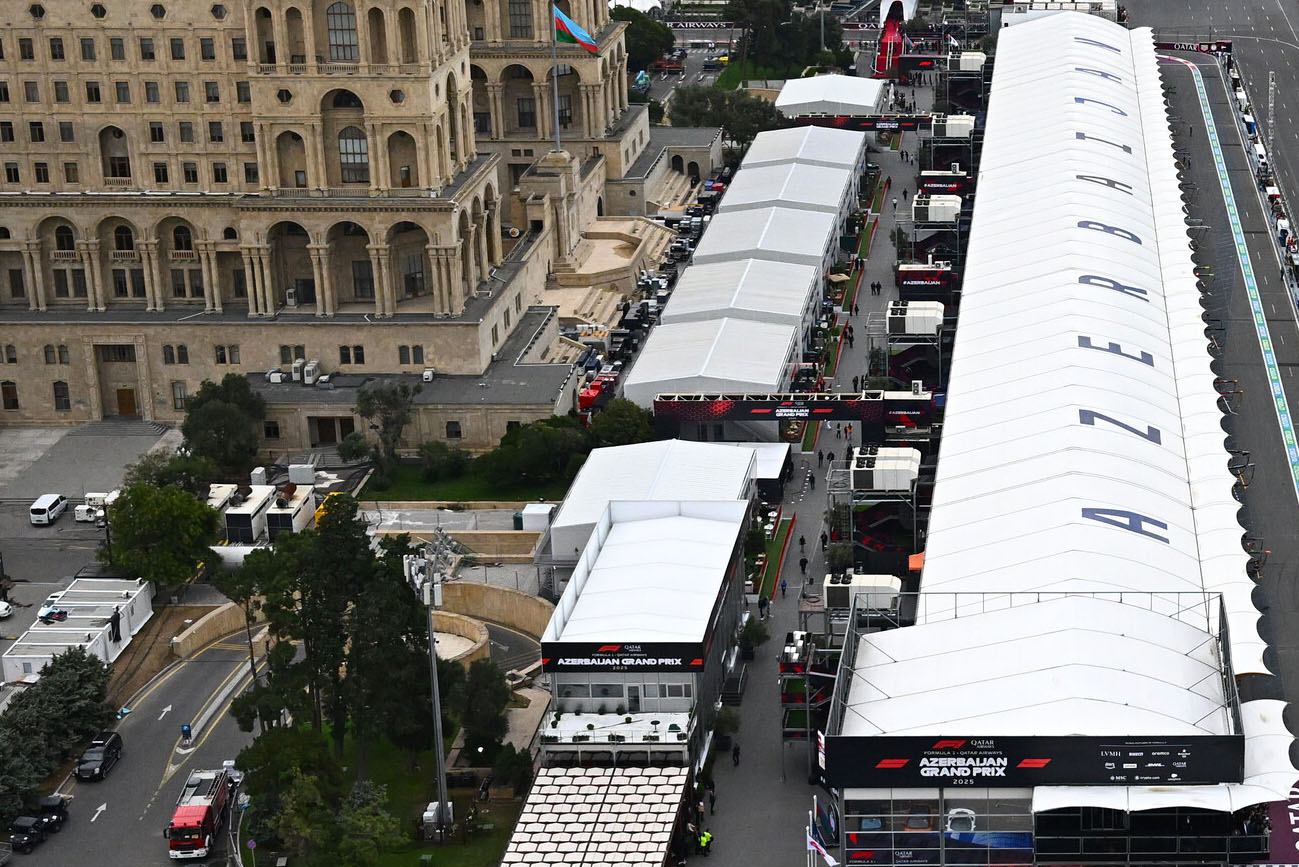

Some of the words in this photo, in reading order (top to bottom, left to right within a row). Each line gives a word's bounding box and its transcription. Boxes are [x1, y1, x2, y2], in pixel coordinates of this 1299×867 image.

[1173, 43, 1198, 52] QATAR
[919, 757, 1008, 767] AZERBAIJAN
[920, 767, 971, 777] GRAND
[972, 767, 1006, 777] PRIX
